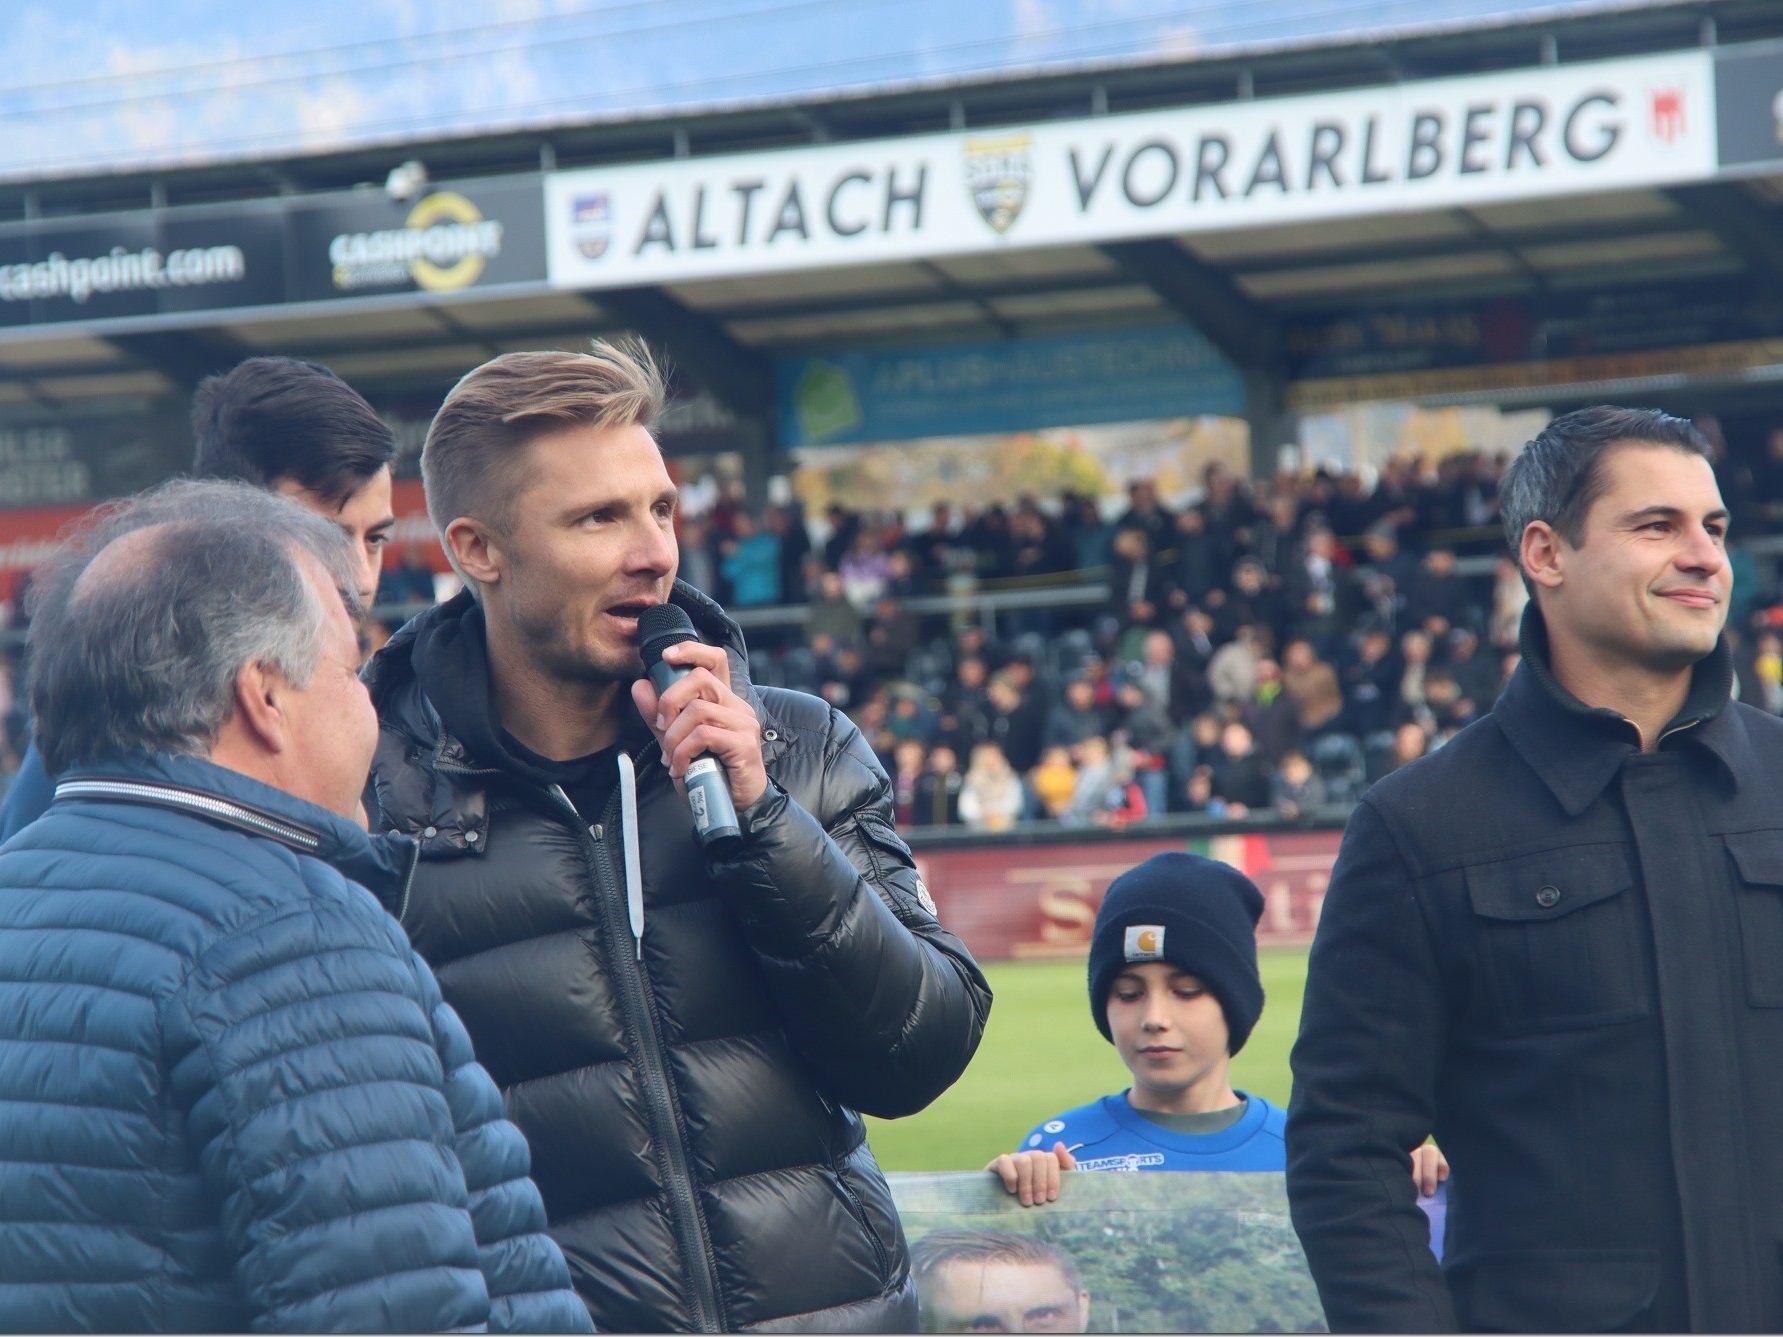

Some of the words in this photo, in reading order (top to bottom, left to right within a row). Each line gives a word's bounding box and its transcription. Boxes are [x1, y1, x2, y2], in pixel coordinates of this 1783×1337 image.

[1068, 91, 1622, 212] VORARLBERG
[329, 220, 503, 267] CASHPOINT
[633, 160, 927, 255] ALTACH
[0, 246, 245, 303] cashpoint.com
